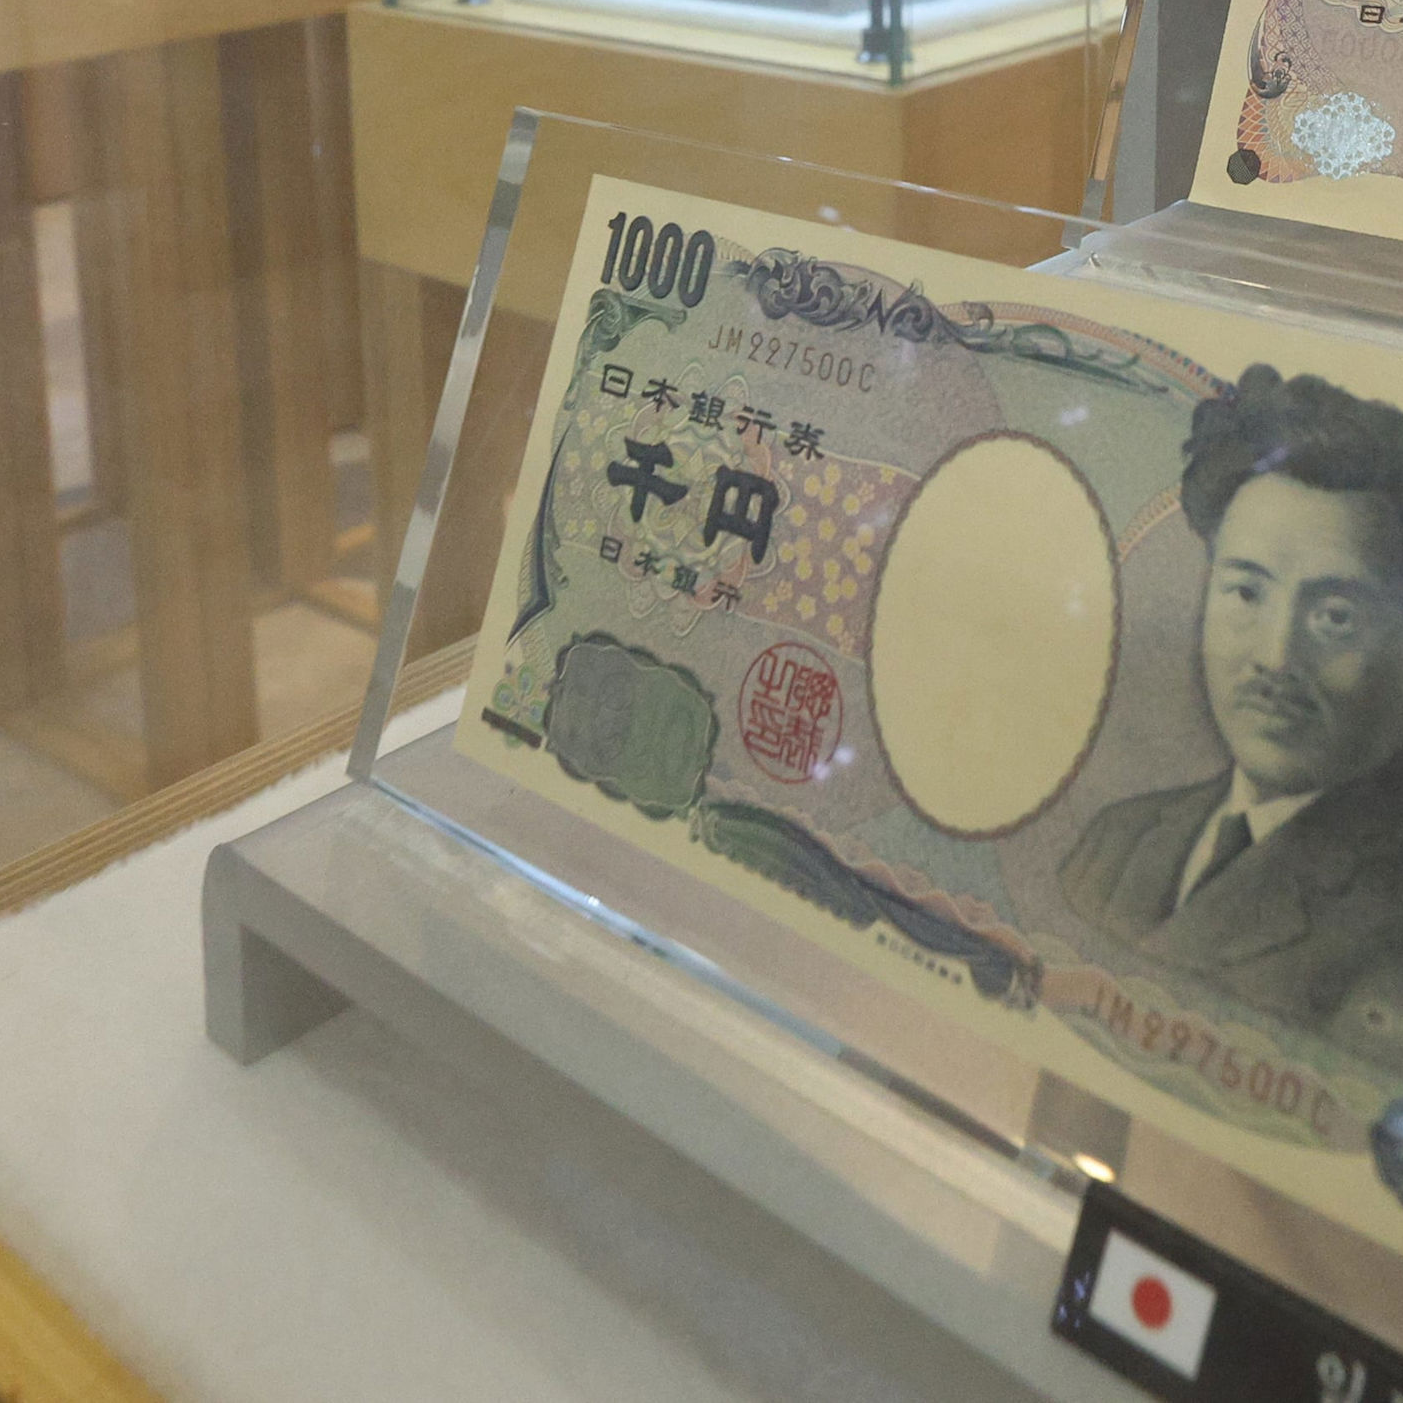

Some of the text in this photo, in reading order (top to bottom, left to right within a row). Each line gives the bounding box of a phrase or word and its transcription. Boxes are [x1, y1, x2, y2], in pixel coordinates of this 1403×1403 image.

[601, 211, 715, 308] 1000
[600, 364, 825, 462] 日本銀行券
[608, 437, 782, 564] 千円
[599, 535, 741, 612] 日本銀行
